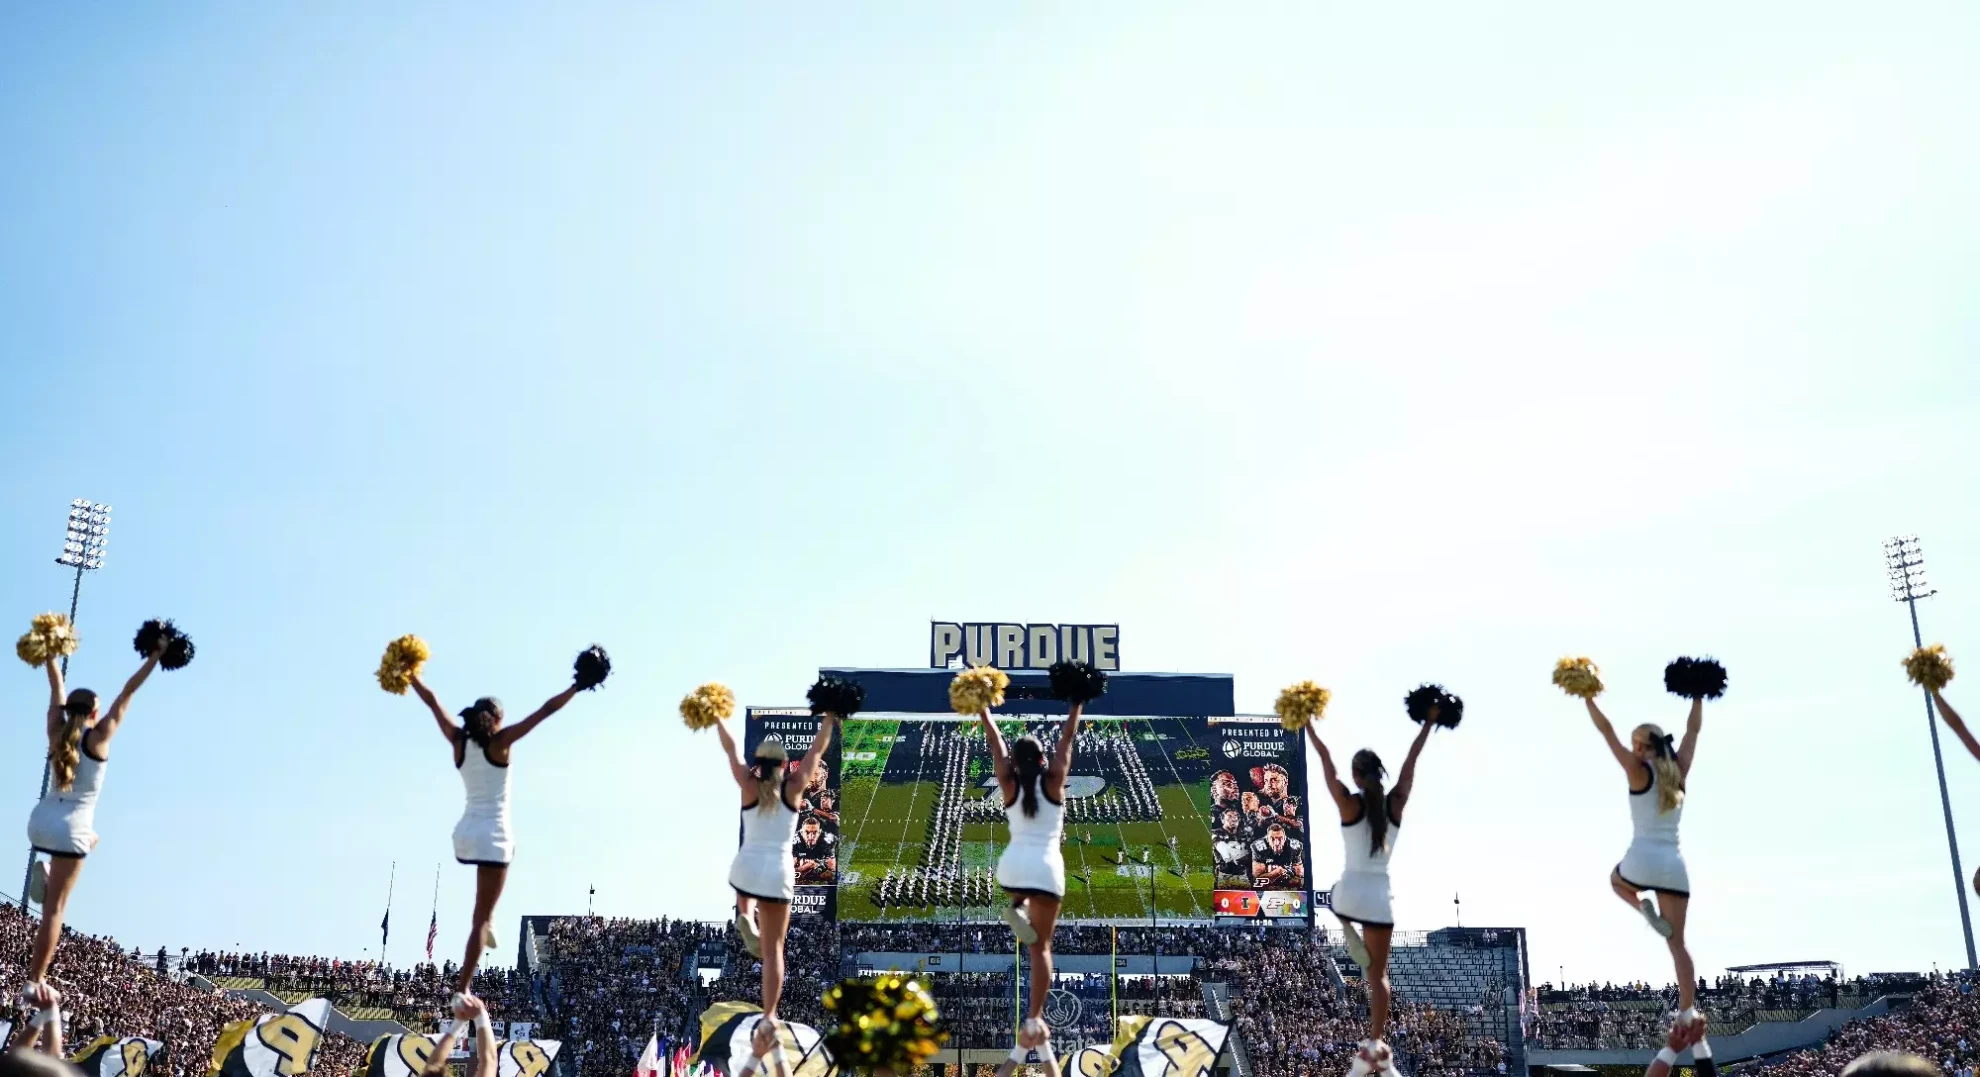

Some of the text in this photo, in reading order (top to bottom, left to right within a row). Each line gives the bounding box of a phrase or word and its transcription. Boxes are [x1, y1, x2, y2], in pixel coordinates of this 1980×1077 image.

[934, 624, 1117, 669] PURDUE
[764, 721, 823, 731] PRESENTED B
[1222, 728, 1284, 737] PRESENTED BY
[785, 734, 816, 743] PURD
[1243, 741, 1285, 751] PURDUE
[790, 895, 826, 906] RDUE
[1221, 897, 1230, 909] 0
[1266, 897, 1301, 910] P 0
[790, 905, 817, 914] OBAL
[1050, 1034, 1097, 1054] state
